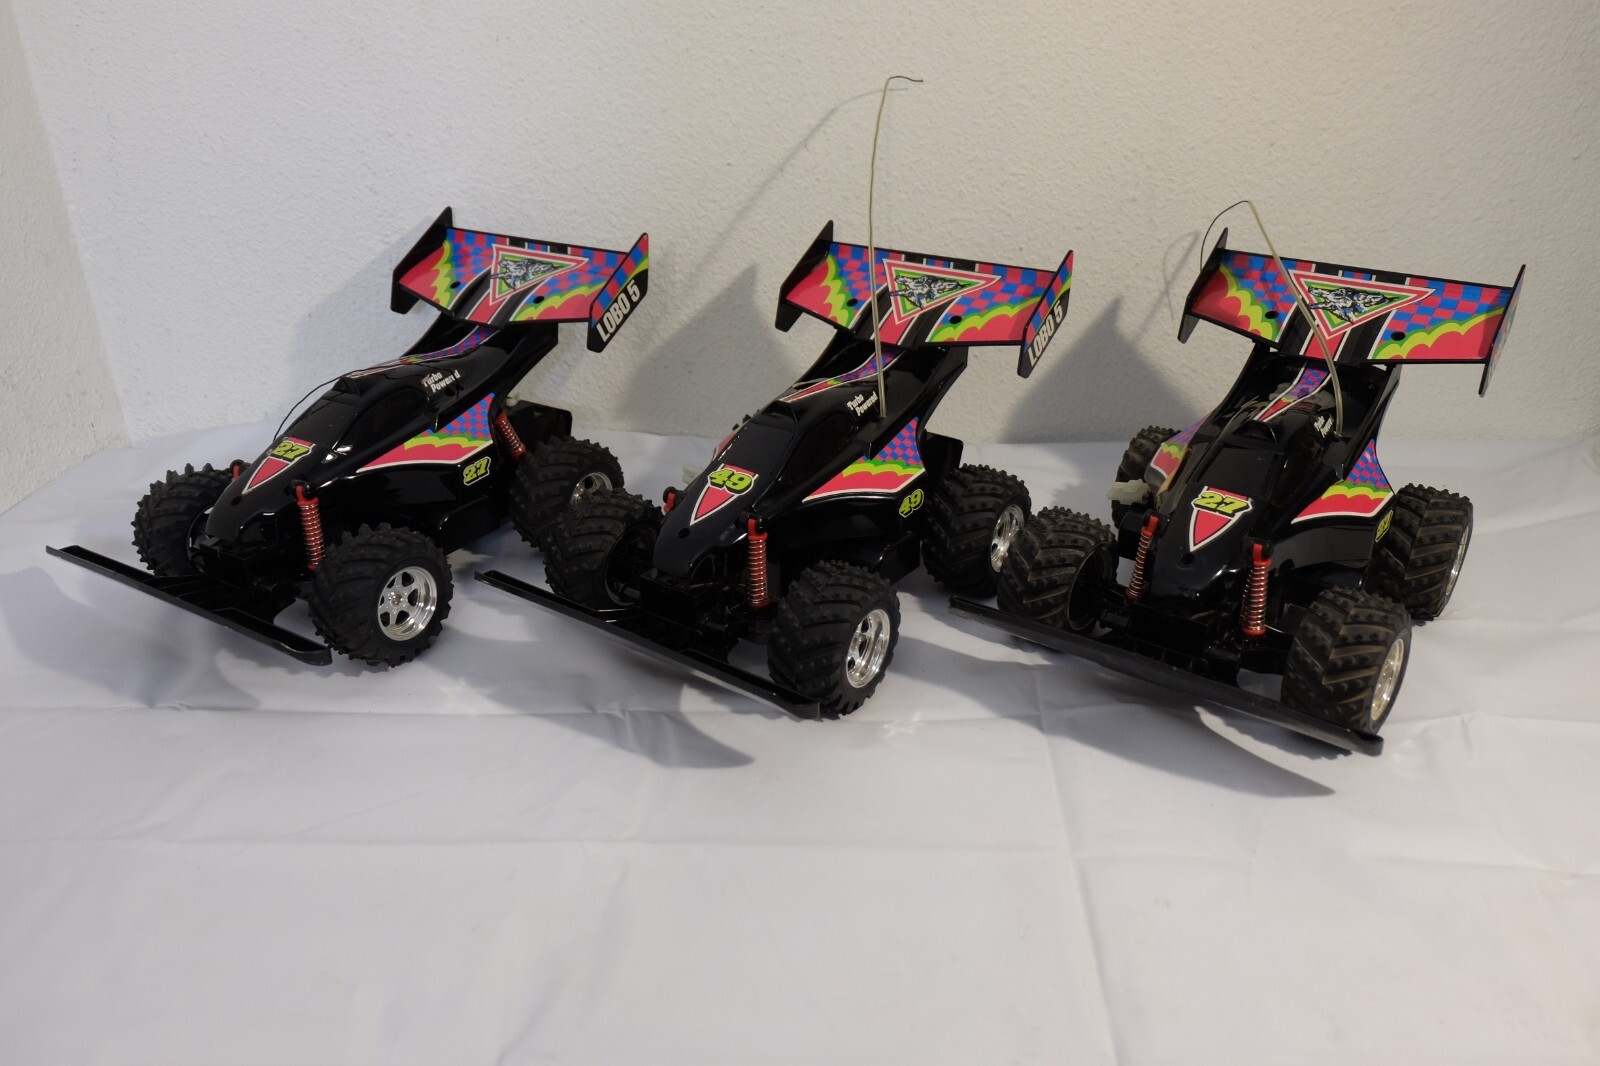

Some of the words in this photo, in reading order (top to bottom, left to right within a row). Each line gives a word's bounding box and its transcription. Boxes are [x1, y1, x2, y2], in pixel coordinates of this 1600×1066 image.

[596, 292, 631, 342] LOBO
[626, 279, 641, 303] 5
[1028, 313, 1055, 367] LOBO
[1053, 299, 1063, 324] 5
[422, 372, 443, 388] Turbo
[430, 370, 461, 393] Powerd
[271, 441, 311, 461] 27
[464, 457, 490, 484] 27
[709, 468, 753, 494] 49
[899, 490, 923, 516] 49
[1193, 491, 1250, 518] 27
